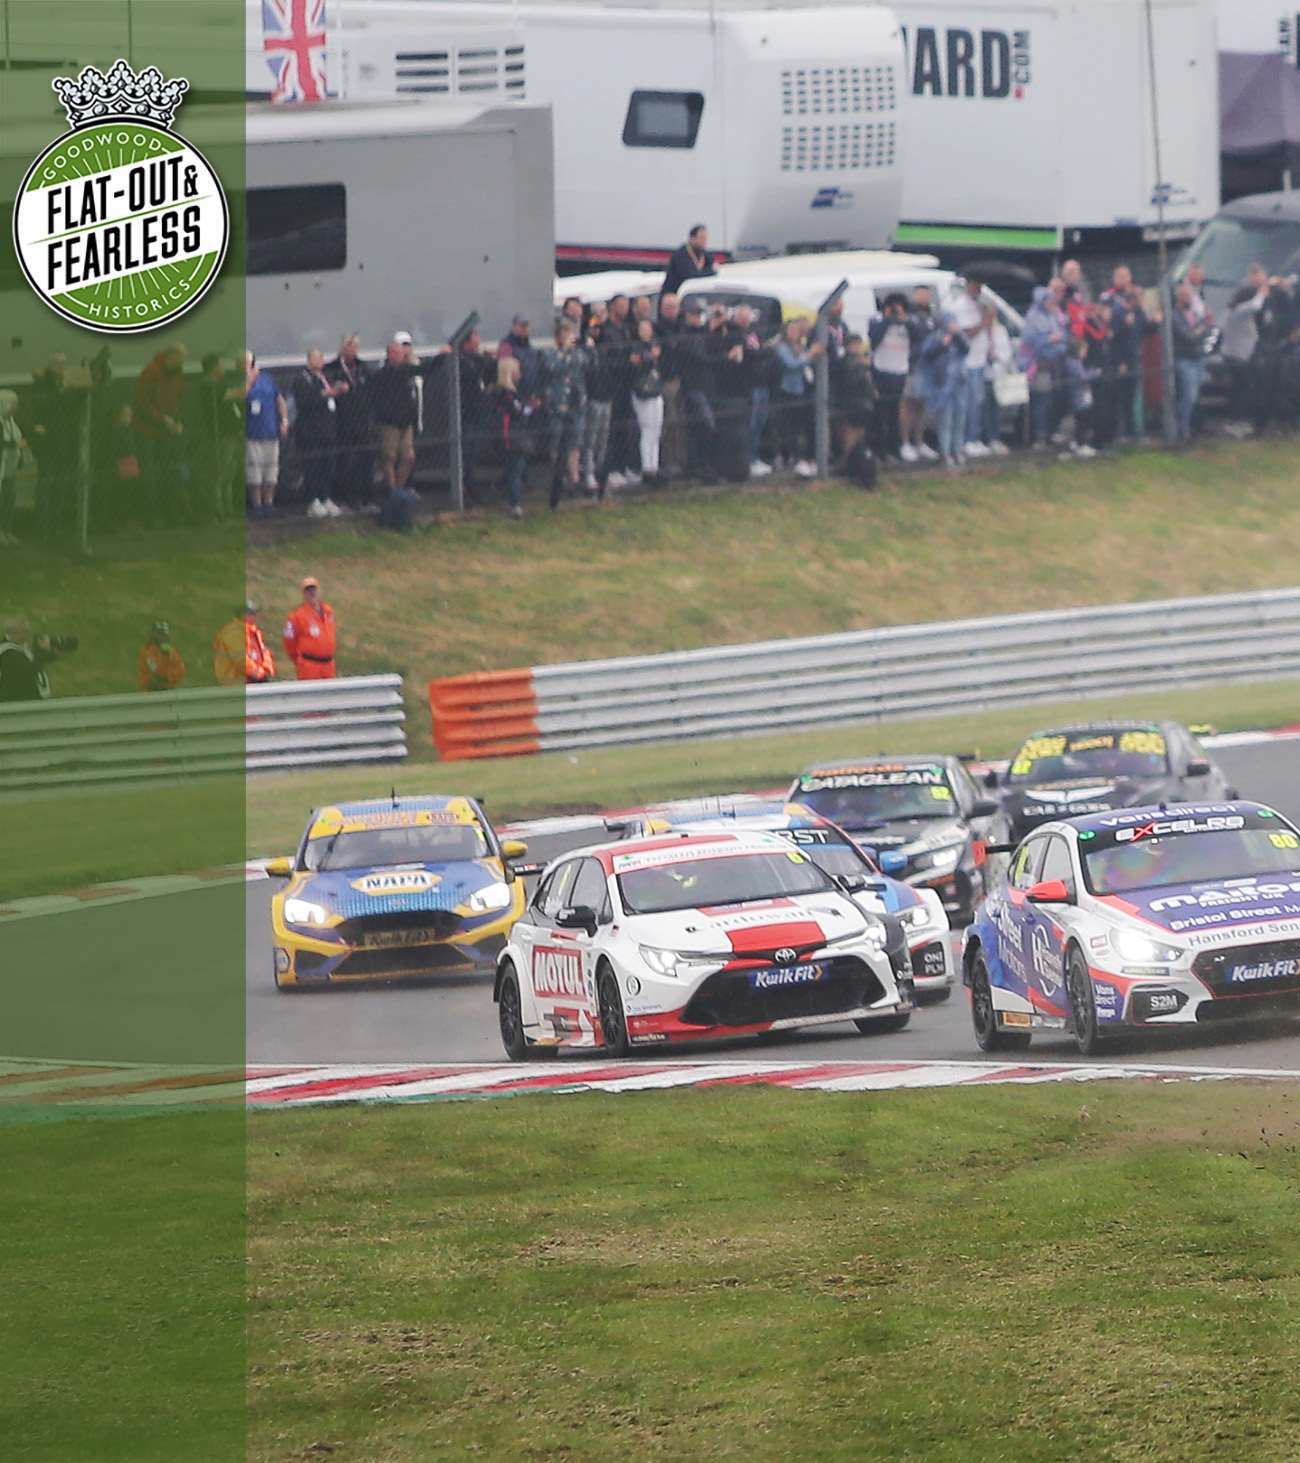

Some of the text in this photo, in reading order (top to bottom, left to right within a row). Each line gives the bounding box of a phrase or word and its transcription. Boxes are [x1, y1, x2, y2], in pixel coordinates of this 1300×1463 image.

[902, 27, 1010, 97] ARD
[367, 876, 428, 889] NAPA
[1169, 911, 1228, 931] Bristol
[1230, 906, 1282, 918] Street
[1189, 924, 1265, 947] Hansford
[534, 951, 586, 996] MOTUL
[1150, 994, 1178, 1008] S2M
